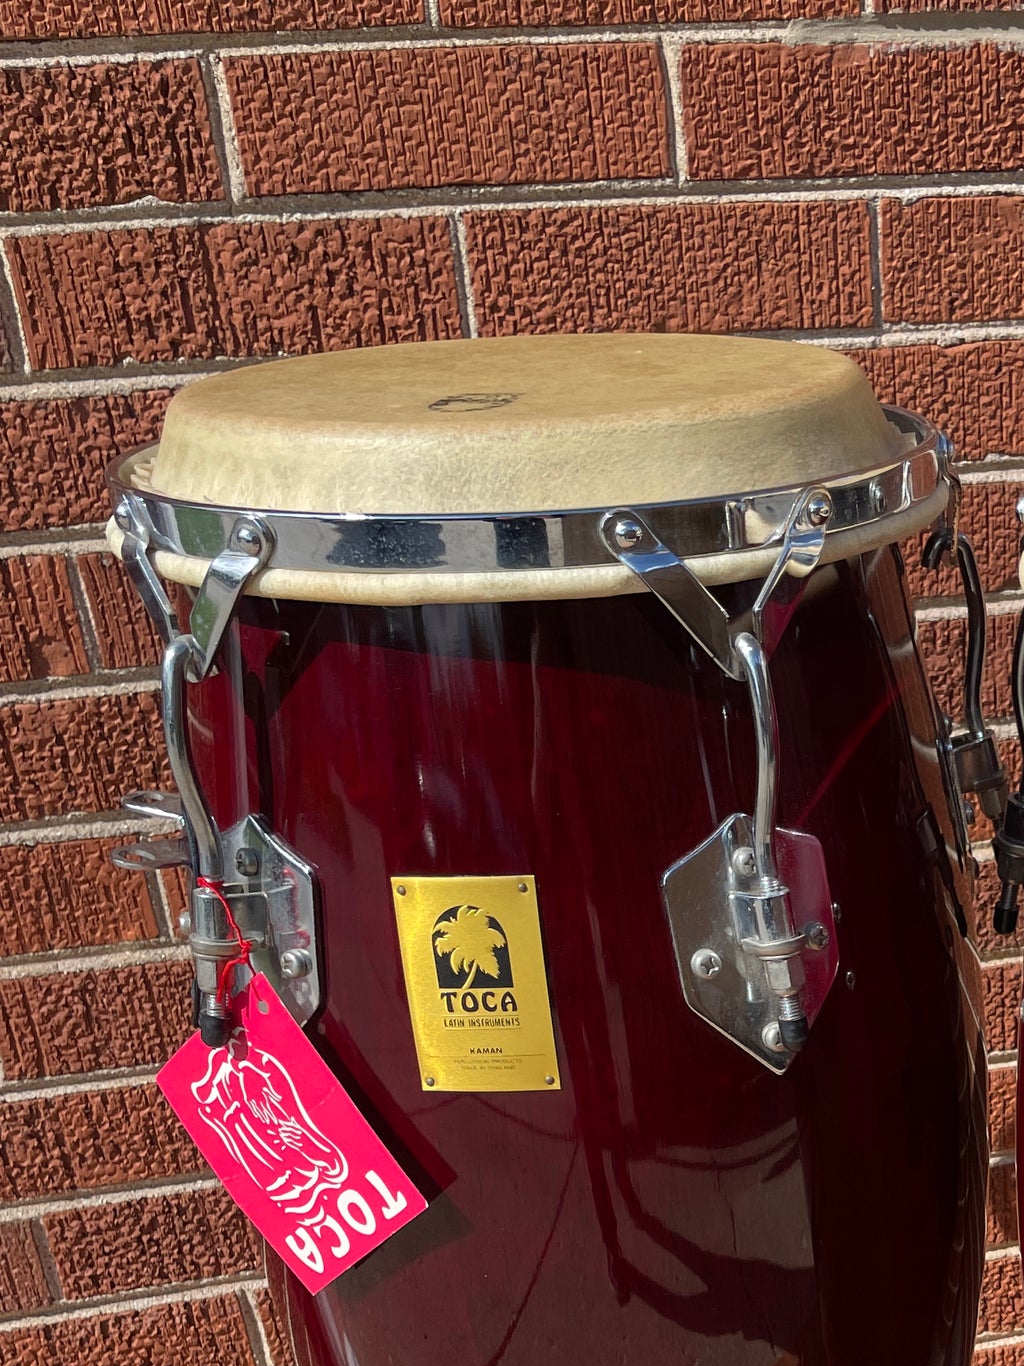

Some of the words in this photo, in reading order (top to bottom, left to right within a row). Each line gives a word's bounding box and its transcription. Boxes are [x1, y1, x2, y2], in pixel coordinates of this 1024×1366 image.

[440, 991, 518, 1013] TOCA
[443, 1018, 465, 1028] LATIN
[468, 1017, 521, 1028] INSTRUMENTS
[469, 1047, 503, 1055] KAMAN
[285, 1170, 407, 1273] TOCA
